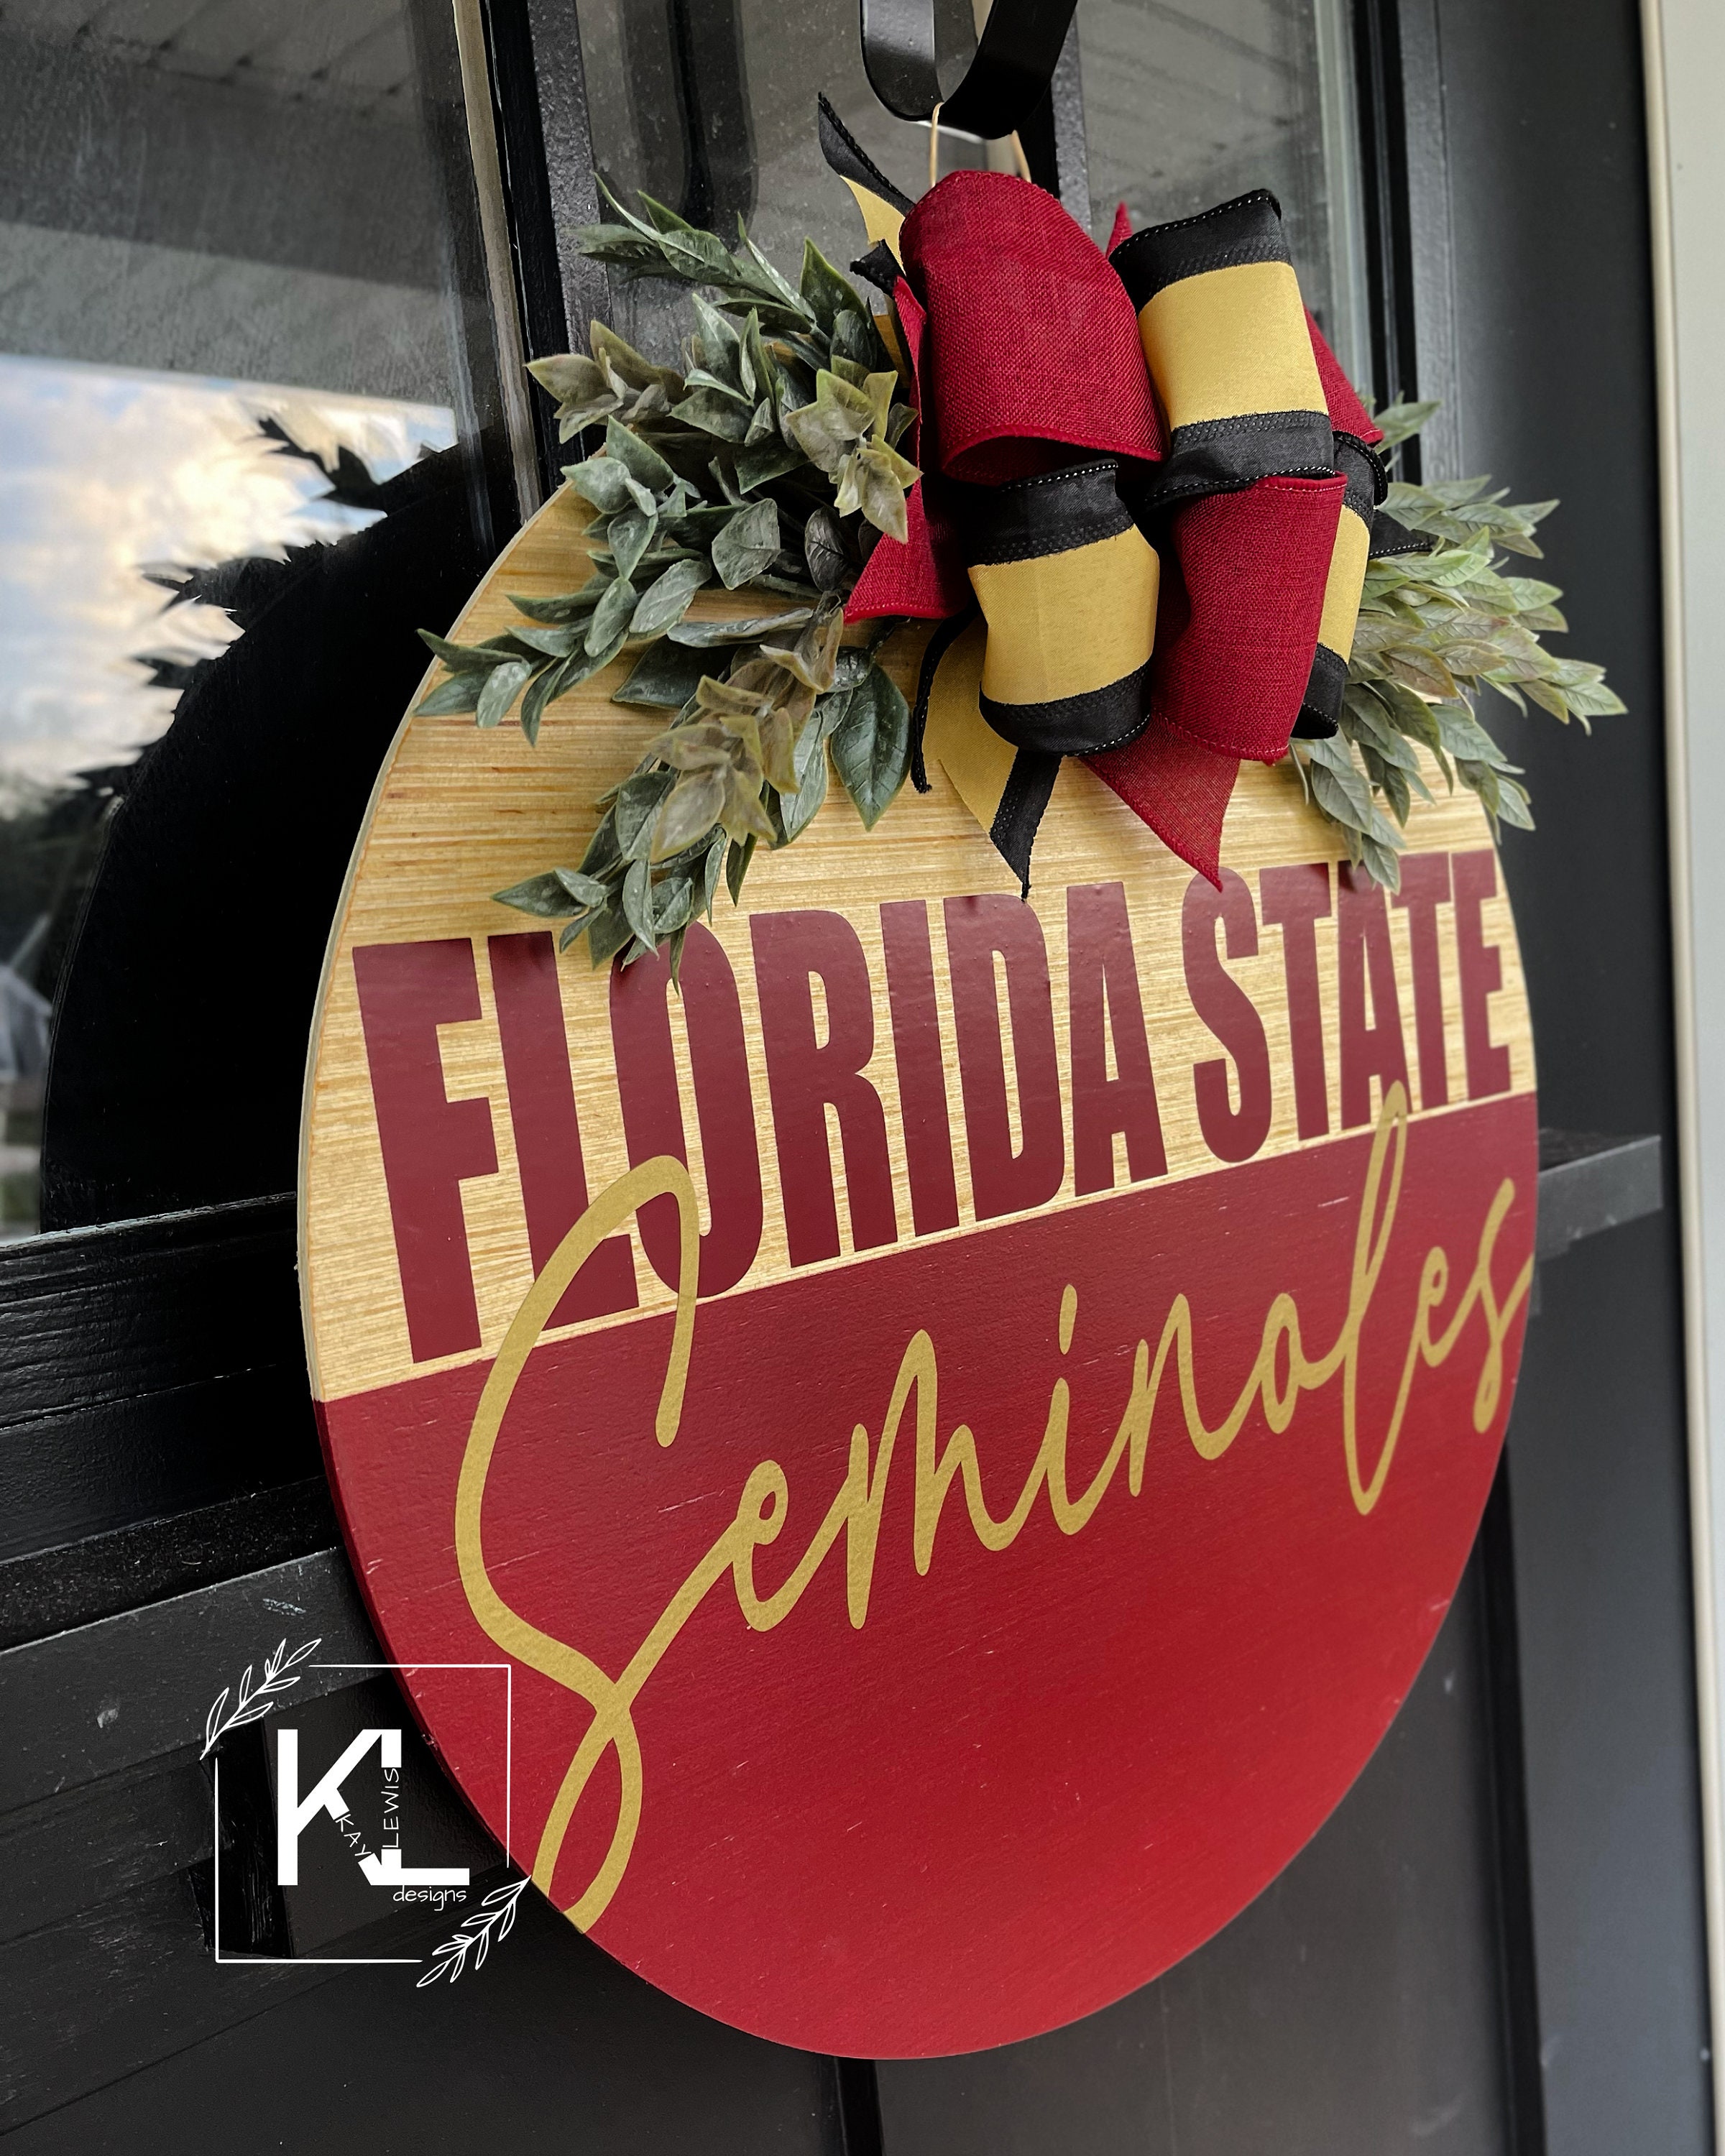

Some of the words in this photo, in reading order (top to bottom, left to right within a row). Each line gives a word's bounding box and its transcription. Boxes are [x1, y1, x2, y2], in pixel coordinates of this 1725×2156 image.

[352, 882, 1169, 1364] FLORIDA
[1182, 849, 1512, 1163] STATE
[454, 1080, 1533, 1933] Seminoles
